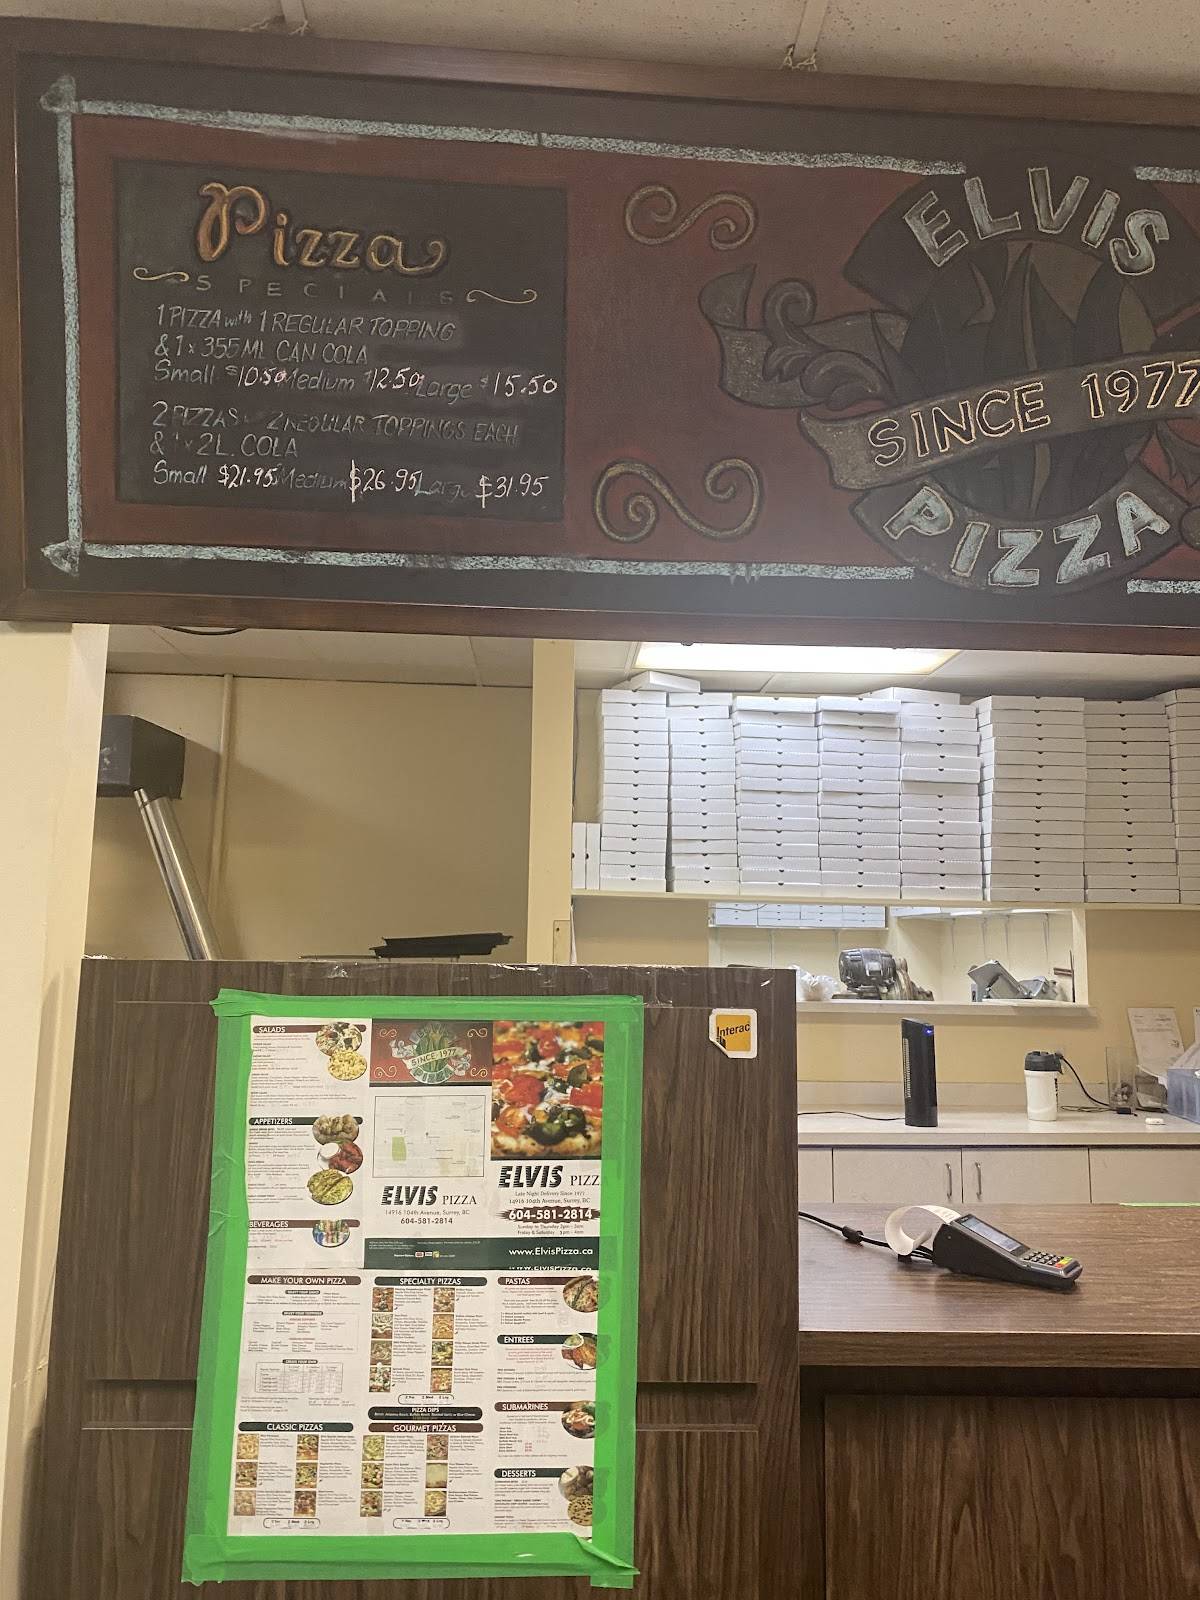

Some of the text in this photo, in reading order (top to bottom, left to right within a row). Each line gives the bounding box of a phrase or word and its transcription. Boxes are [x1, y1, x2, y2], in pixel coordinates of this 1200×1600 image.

[197, 182, 446, 276] Pizza
[904, 166, 1170, 276] ELVIS
[169, 305, 222, 329] PIZZA
[224, 309, 252, 328] with
[260, 309, 267, 332] 1
[272, 312, 364, 337] REGULAR
[369, 317, 456, 341] TOPPING
[154, 333, 169, 357] &
[276, 339, 317, 363] CAN
[322, 342, 368, 365] COLA
[154, 358, 215, 385] Small
[285, 367, 355, 391] Medium
[364, 366, 425, 392] $12.50
[416, 376, 473, 405] Large
[480, 371, 558, 398] $15.50
[867, 358, 1200, 467] SINCE 1977
[371, 413, 465, 441] TOPPINGS
[474, 422, 520, 447] EACH
[150, 431, 165, 456] &
[241, 433, 298, 457] COLA
[153, 459, 208, 485] Small
[217, 463, 278, 489] $21.95
[279, 465, 347, 490] Medium
[349, 459, 423, 503] $26.95
[475, 472, 550, 508] $31.95
[883, 485, 1172, 588] PIZZA
[716, 1022, 751, 1038] Interac
[411, 1048, 458, 1067] SINCE 1977
[253, 1117, 293, 1125] APPETIZERS
[498, 1165, 600, 1188] ELVIS PIZZ
[380, 1185, 478, 1206] ELVIS PIZZA
[400, 1217, 454, 1225] 604-581-2814
[508, 1209, 593, 1220] 604-581-2814
[248, 1220, 289, 1228] BEVERAGES
[508, 1246, 594, 1256] www.ElvisPizza.ca
[260, 1277, 347, 1285] MAKE YOUR OWN PIZZA
[399, 1277, 462, 1286] SPECIALTY PIZZAS
[505, 1277, 531, 1285] PASTAS
[503, 1336, 534, 1344] ENTREES
[502, 1403, 549, 1411] SUBMARINES
[266, 1423, 324, 1431] CLASSIC PIZZAS
[393, 1424, 457, 1432] GOURMET PIZZAS
[501, 1469, 537, 1478] DESSERTS
